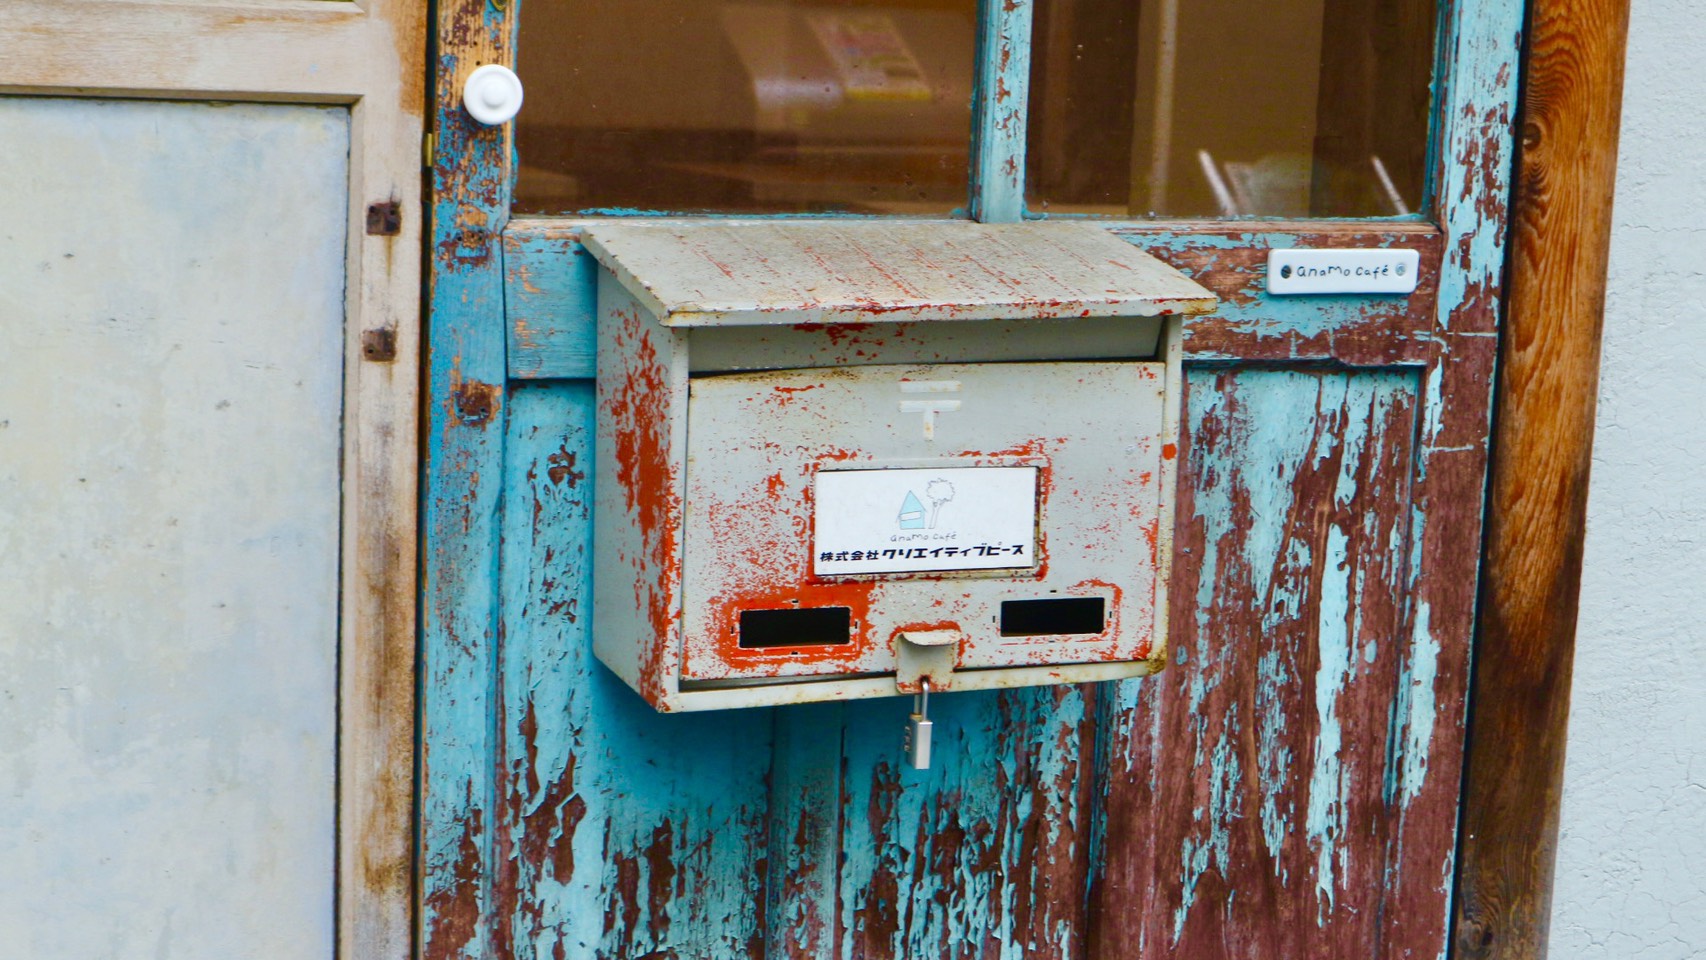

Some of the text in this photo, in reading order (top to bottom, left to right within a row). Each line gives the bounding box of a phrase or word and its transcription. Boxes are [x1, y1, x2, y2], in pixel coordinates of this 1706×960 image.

[819, 541, 1025, 563] 株式会社クリエイティブピース
